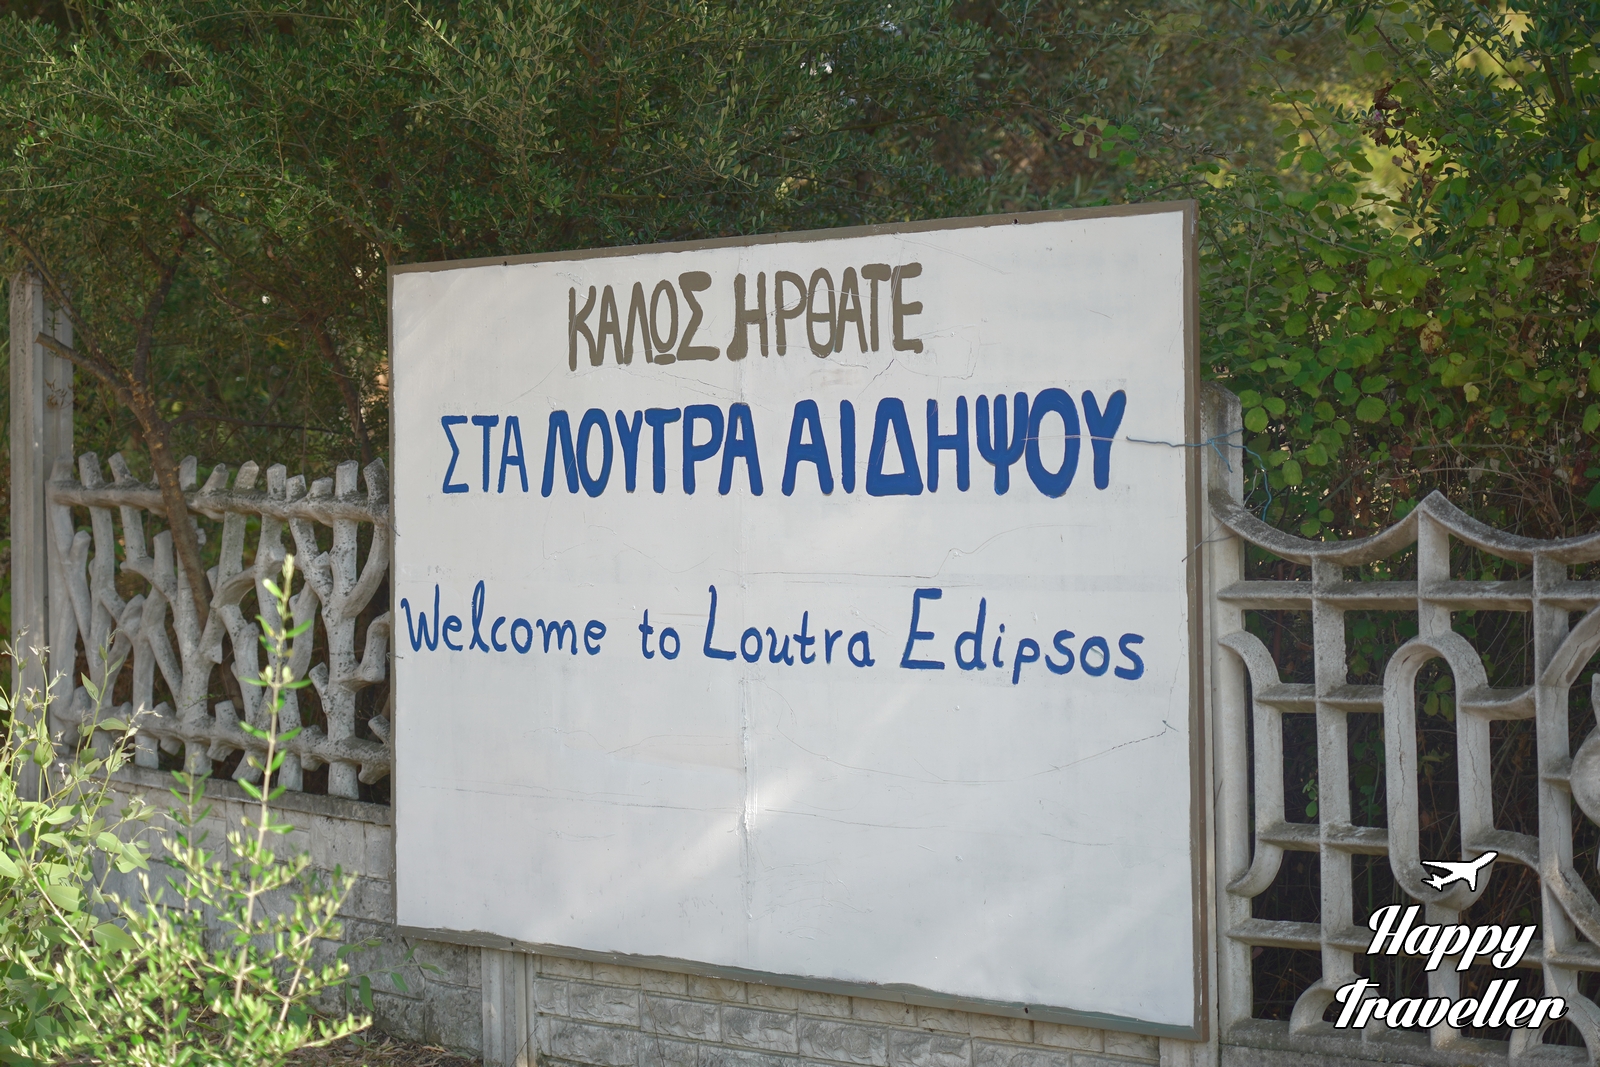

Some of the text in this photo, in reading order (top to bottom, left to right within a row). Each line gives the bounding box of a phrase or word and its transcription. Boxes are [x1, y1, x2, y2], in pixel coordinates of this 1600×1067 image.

[726, 262, 923, 361] ΗΡΘΑΤΕ
[441, 388, 1127, 499] ΣΤΑ ΛΟΥΤΡΑ ΑΙΔΗΨΟΥ
[400, 580, 1145, 685] Welcome to Loutra Edipsos
